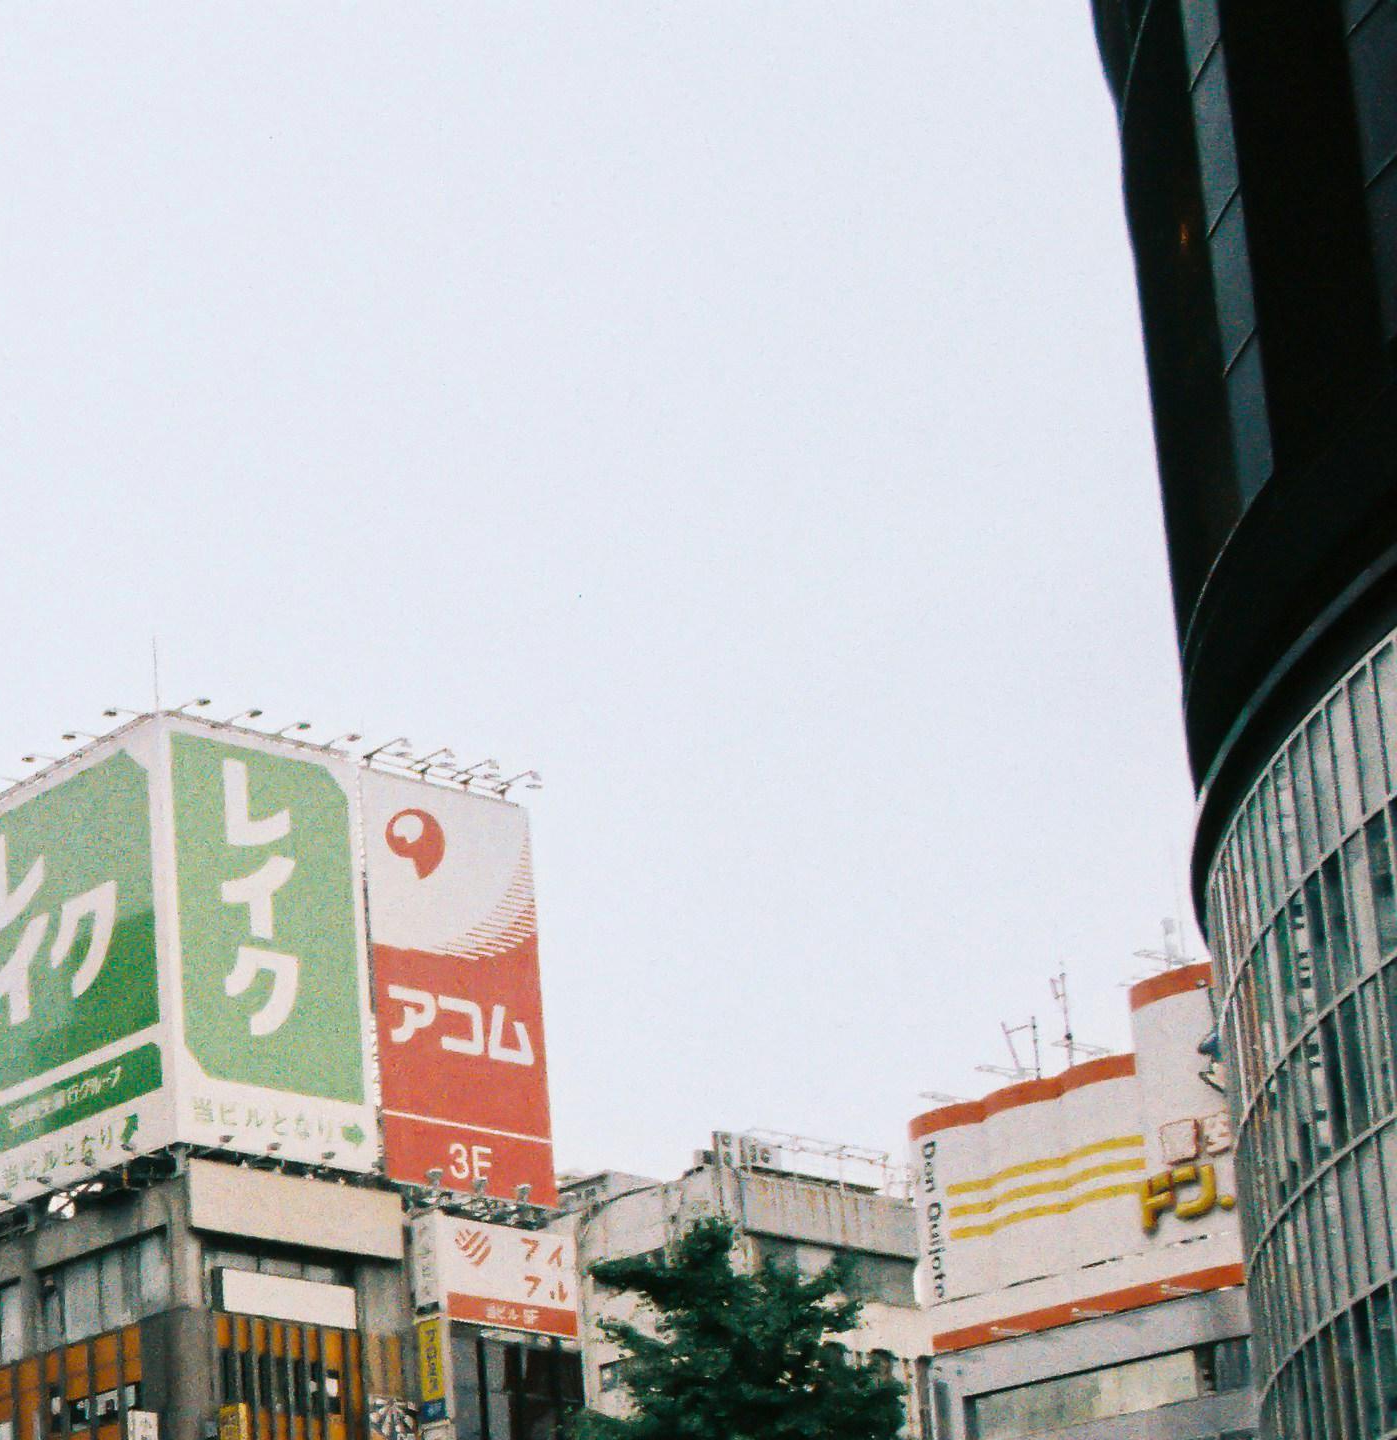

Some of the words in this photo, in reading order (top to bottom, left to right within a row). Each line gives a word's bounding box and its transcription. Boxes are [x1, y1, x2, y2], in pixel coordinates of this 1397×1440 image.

[220, 757, 301, 1037] レイク
[387, 984, 535, 1067] アコム
[448, 1142, 493, 1179] 3F
